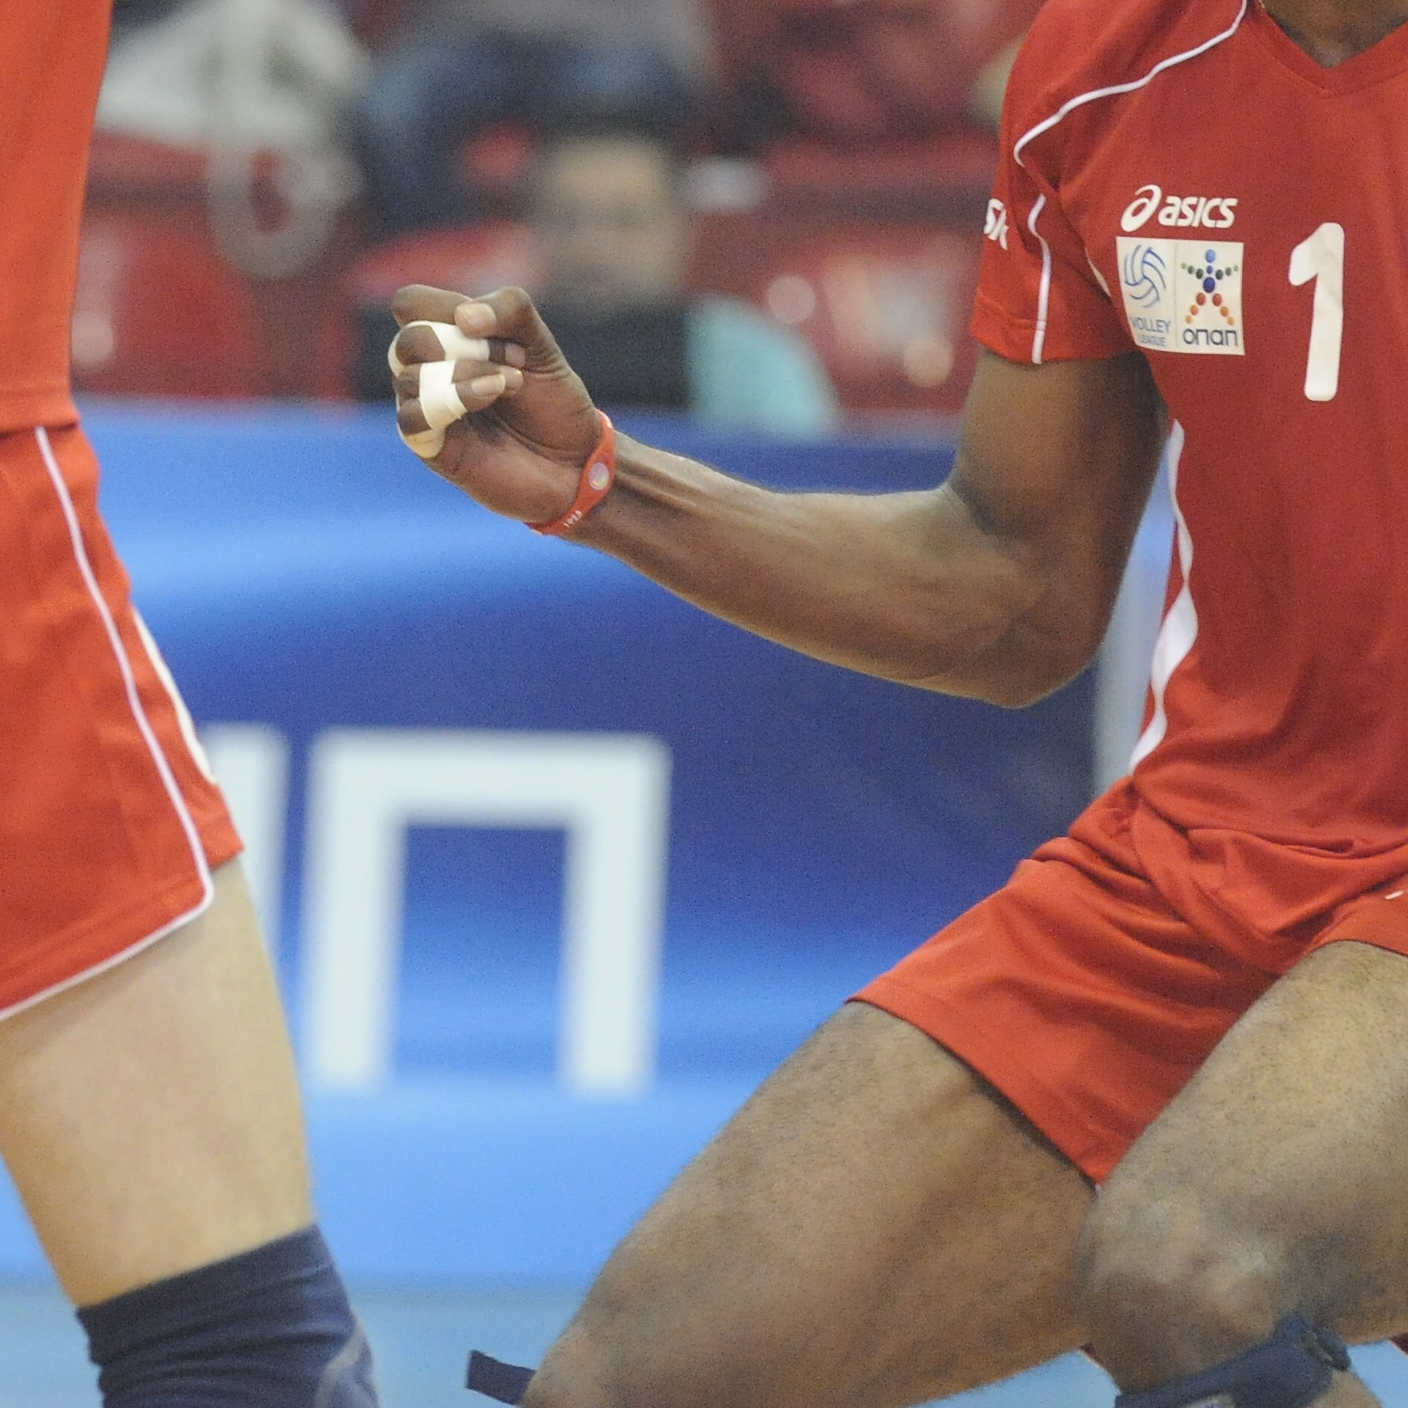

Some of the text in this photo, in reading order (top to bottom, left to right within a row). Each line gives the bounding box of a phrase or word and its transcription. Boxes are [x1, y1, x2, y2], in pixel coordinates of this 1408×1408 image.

[1158, 195, 1239, 229] asics
[1132, 316, 1171, 334] VOLLEY
[1288, 222, 1344, 402] 1
